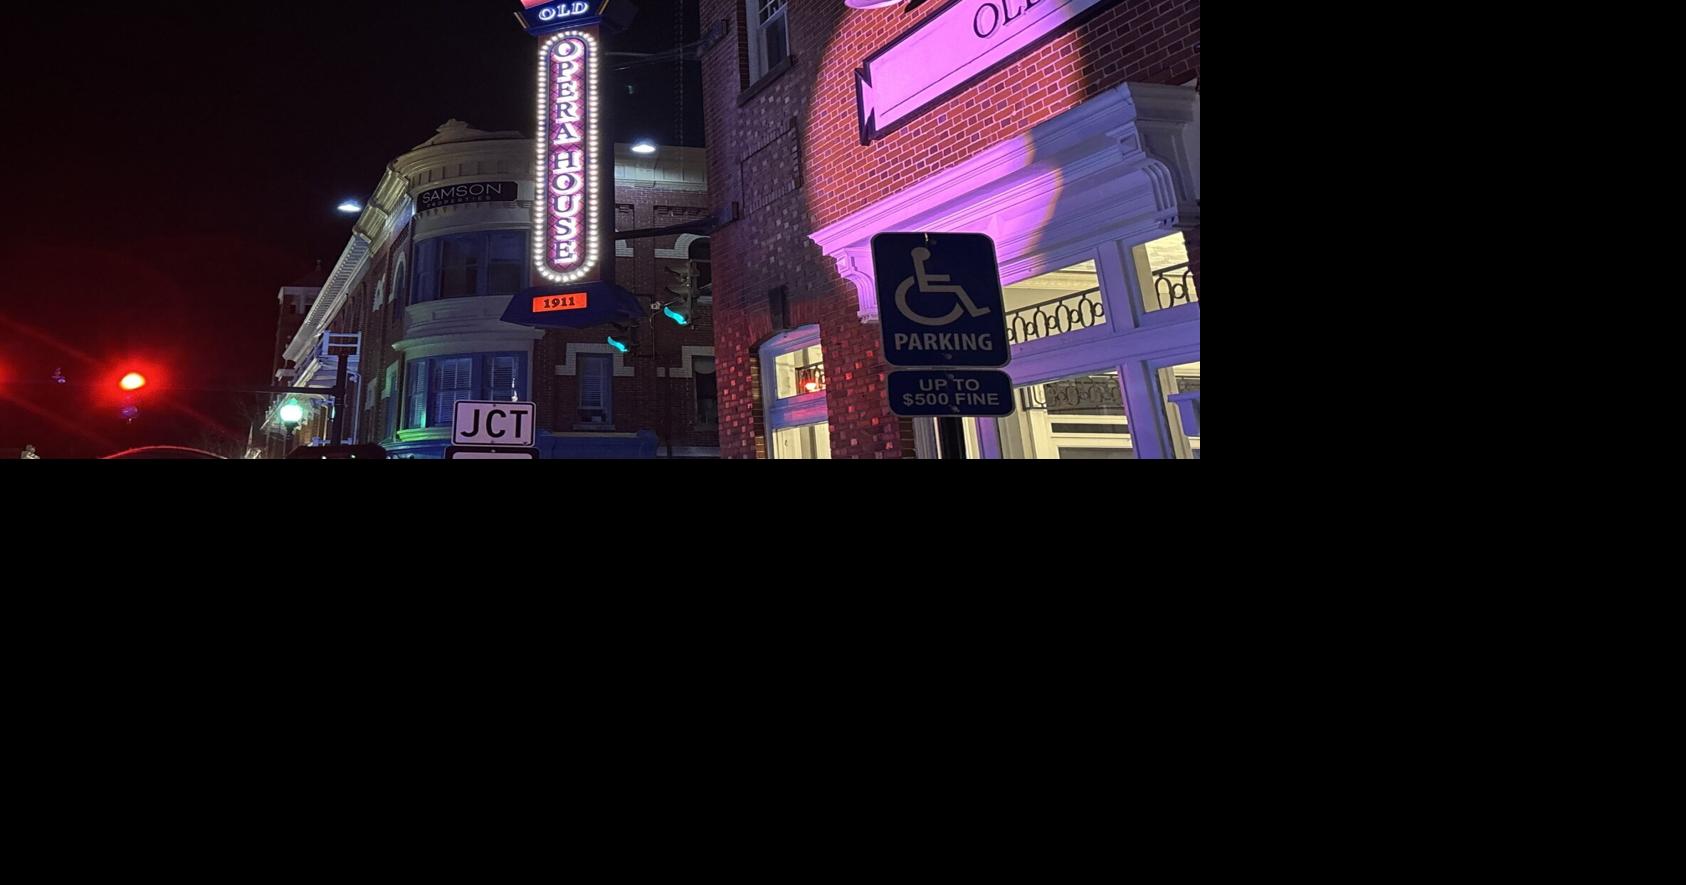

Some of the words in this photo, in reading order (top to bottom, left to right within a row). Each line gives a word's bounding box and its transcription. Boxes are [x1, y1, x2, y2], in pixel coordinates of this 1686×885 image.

[538, 1, 589, 20] OLD
[973, 0, 1041, 39] OL
[554, 41, 580, 142] OPERA
[422, 183, 501, 204] SAMSON
[552, 151, 580, 262] HOUSE
[543, 296, 575, 308] 1911
[894, 333, 993, 351] PARKING
[919, 379, 947, 391] UP
[953, 379, 980, 391] TO
[902, 393, 949, 407] $500
[955, 393, 1000, 406] FINE
[460, 409, 528, 439] JCT
